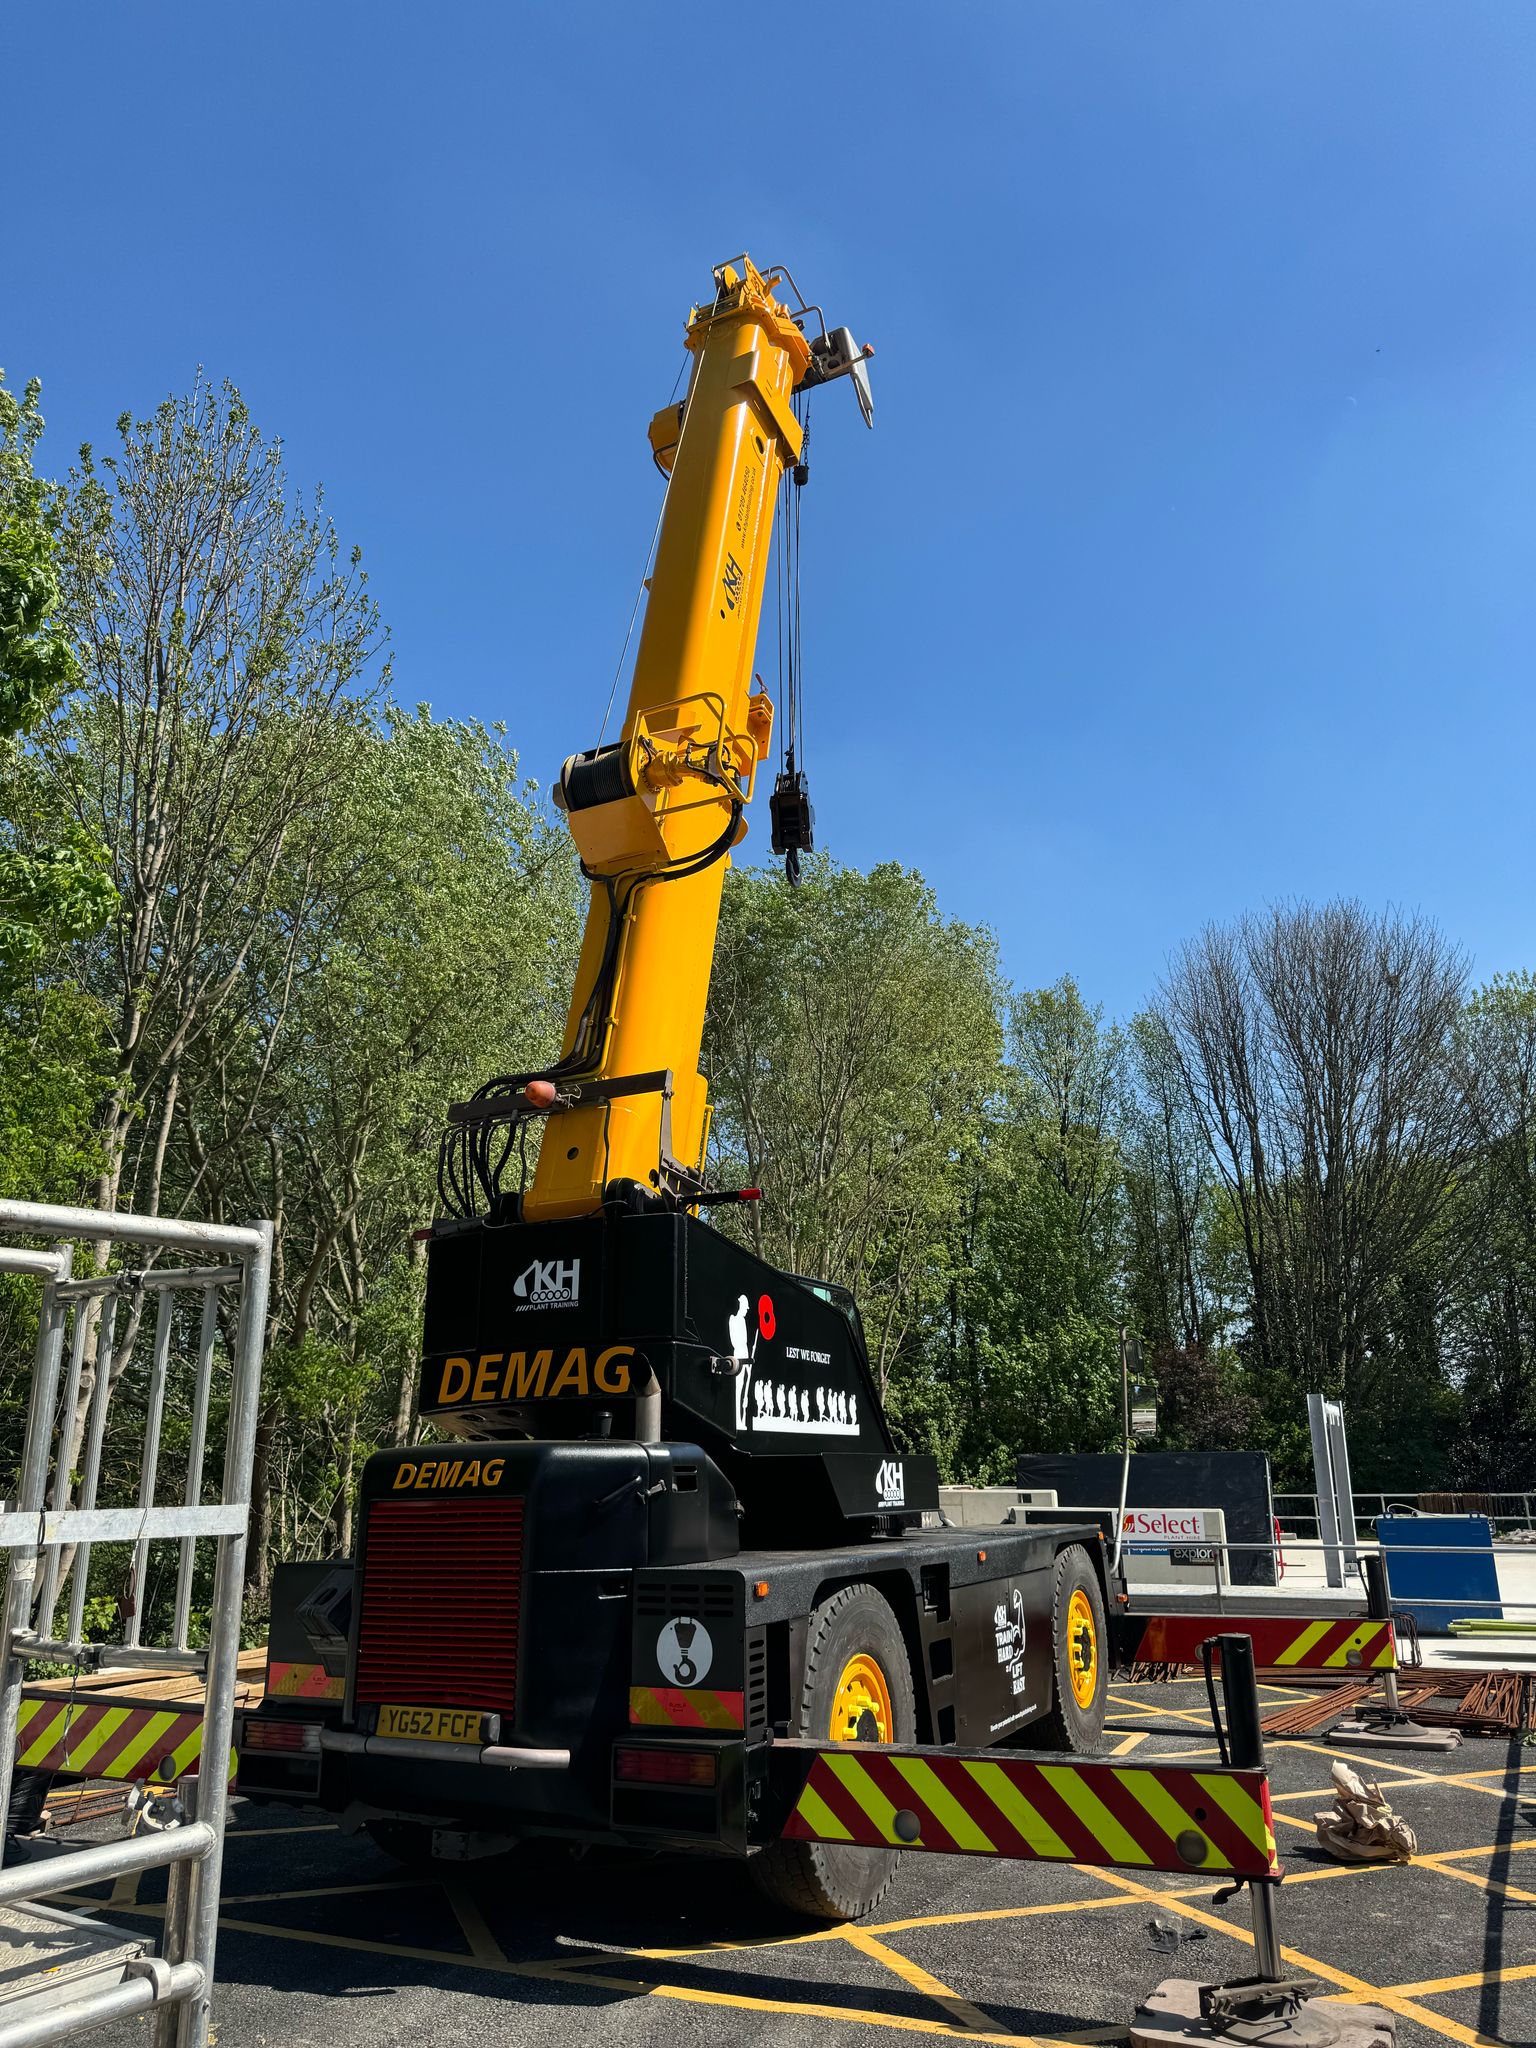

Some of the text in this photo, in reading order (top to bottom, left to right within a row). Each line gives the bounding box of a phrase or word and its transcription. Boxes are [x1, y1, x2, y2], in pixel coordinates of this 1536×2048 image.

[722, 552, 743, 598] KH
[534, 1259, 580, 1300] KH
[529, 1301, 579, 1311] PLANT TRAINING
[786, 1346, 831, 1365] LEST WE FORGET
[437, 1345, 635, 1404] DEMAG
[392, 1459, 505, 1490] DEMAG
[883, 1460, 905, 1500] KH
[1137, 1513, 1200, 1534] Select
[995, 1629, 1014, 1647] TRAIN
[997, 1645, 1014, 1664] HARD
[1012, 1661, 1023, 1679] LIFT
[1013, 1675, 1026, 1695] EASY
[389, 1709, 477, 1738] YG52 FCF
